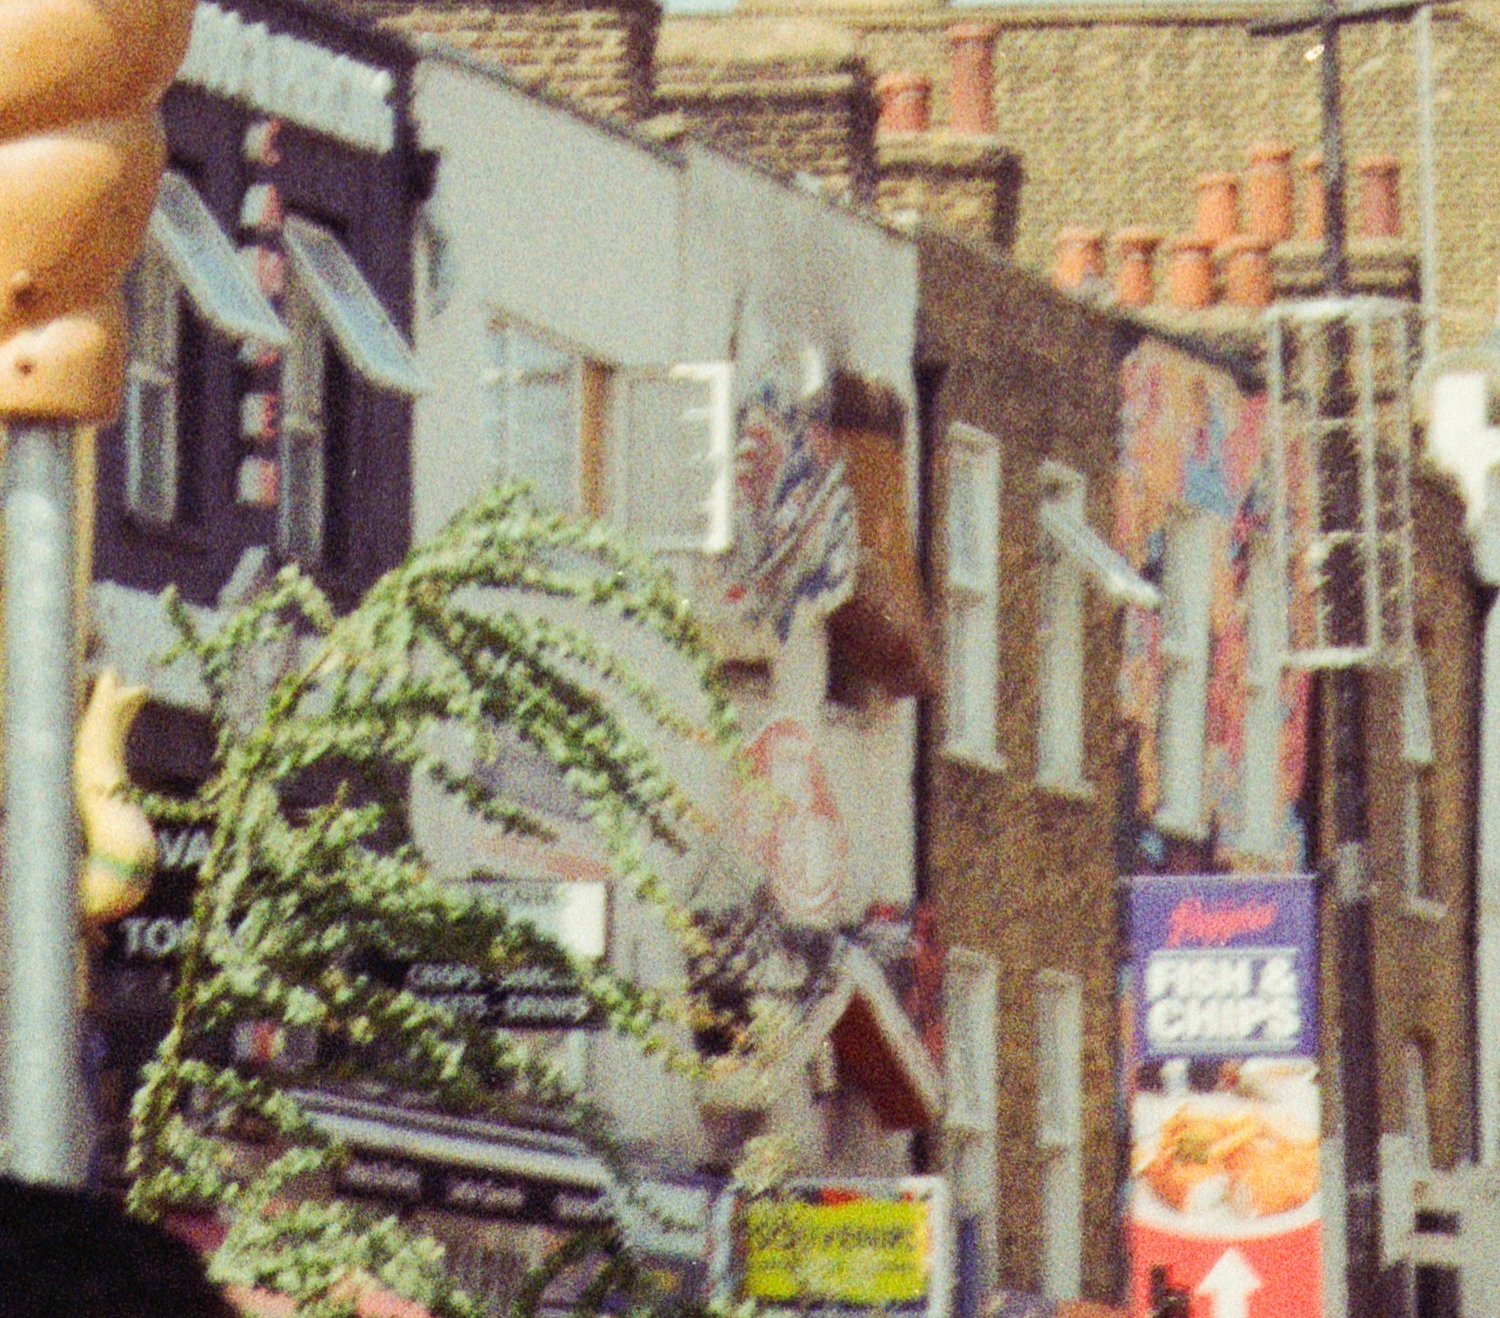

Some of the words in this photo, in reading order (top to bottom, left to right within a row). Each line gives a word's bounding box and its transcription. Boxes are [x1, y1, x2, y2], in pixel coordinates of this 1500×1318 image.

[1145, 956, 1252, 999] FISH
[1259, 955, 1297, 997] &
[1147, 997, 1302, 1041] CHIPS
